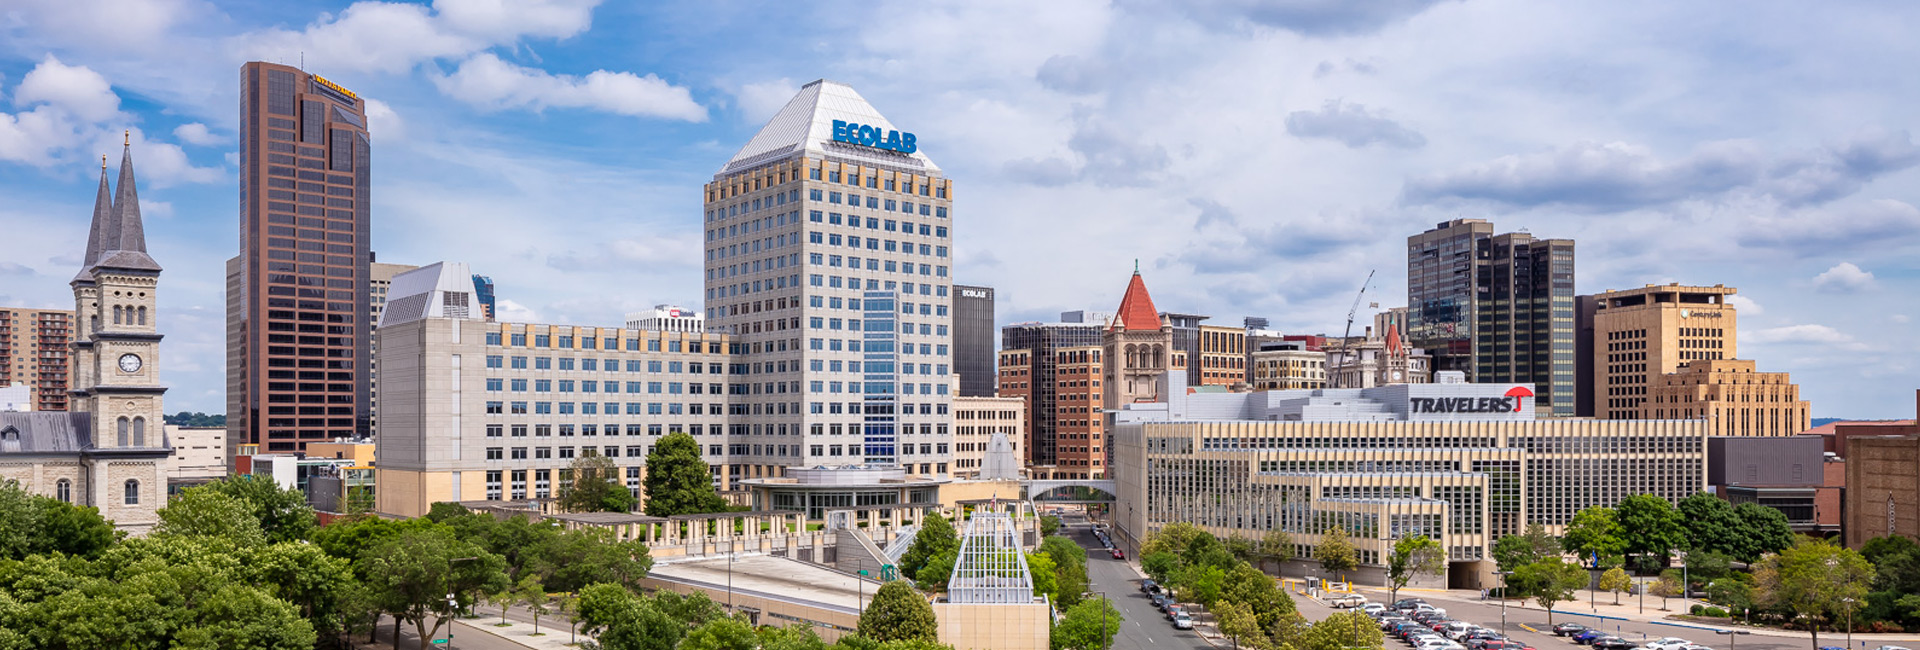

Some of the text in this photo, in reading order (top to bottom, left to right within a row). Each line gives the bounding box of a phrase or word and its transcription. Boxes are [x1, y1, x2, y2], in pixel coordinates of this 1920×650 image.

[832, 119, 917, 154] ECOLAB
[962, 290, 986, 298] ECOLAB
[1410, 397, 1513, 413] TRAVELERS
